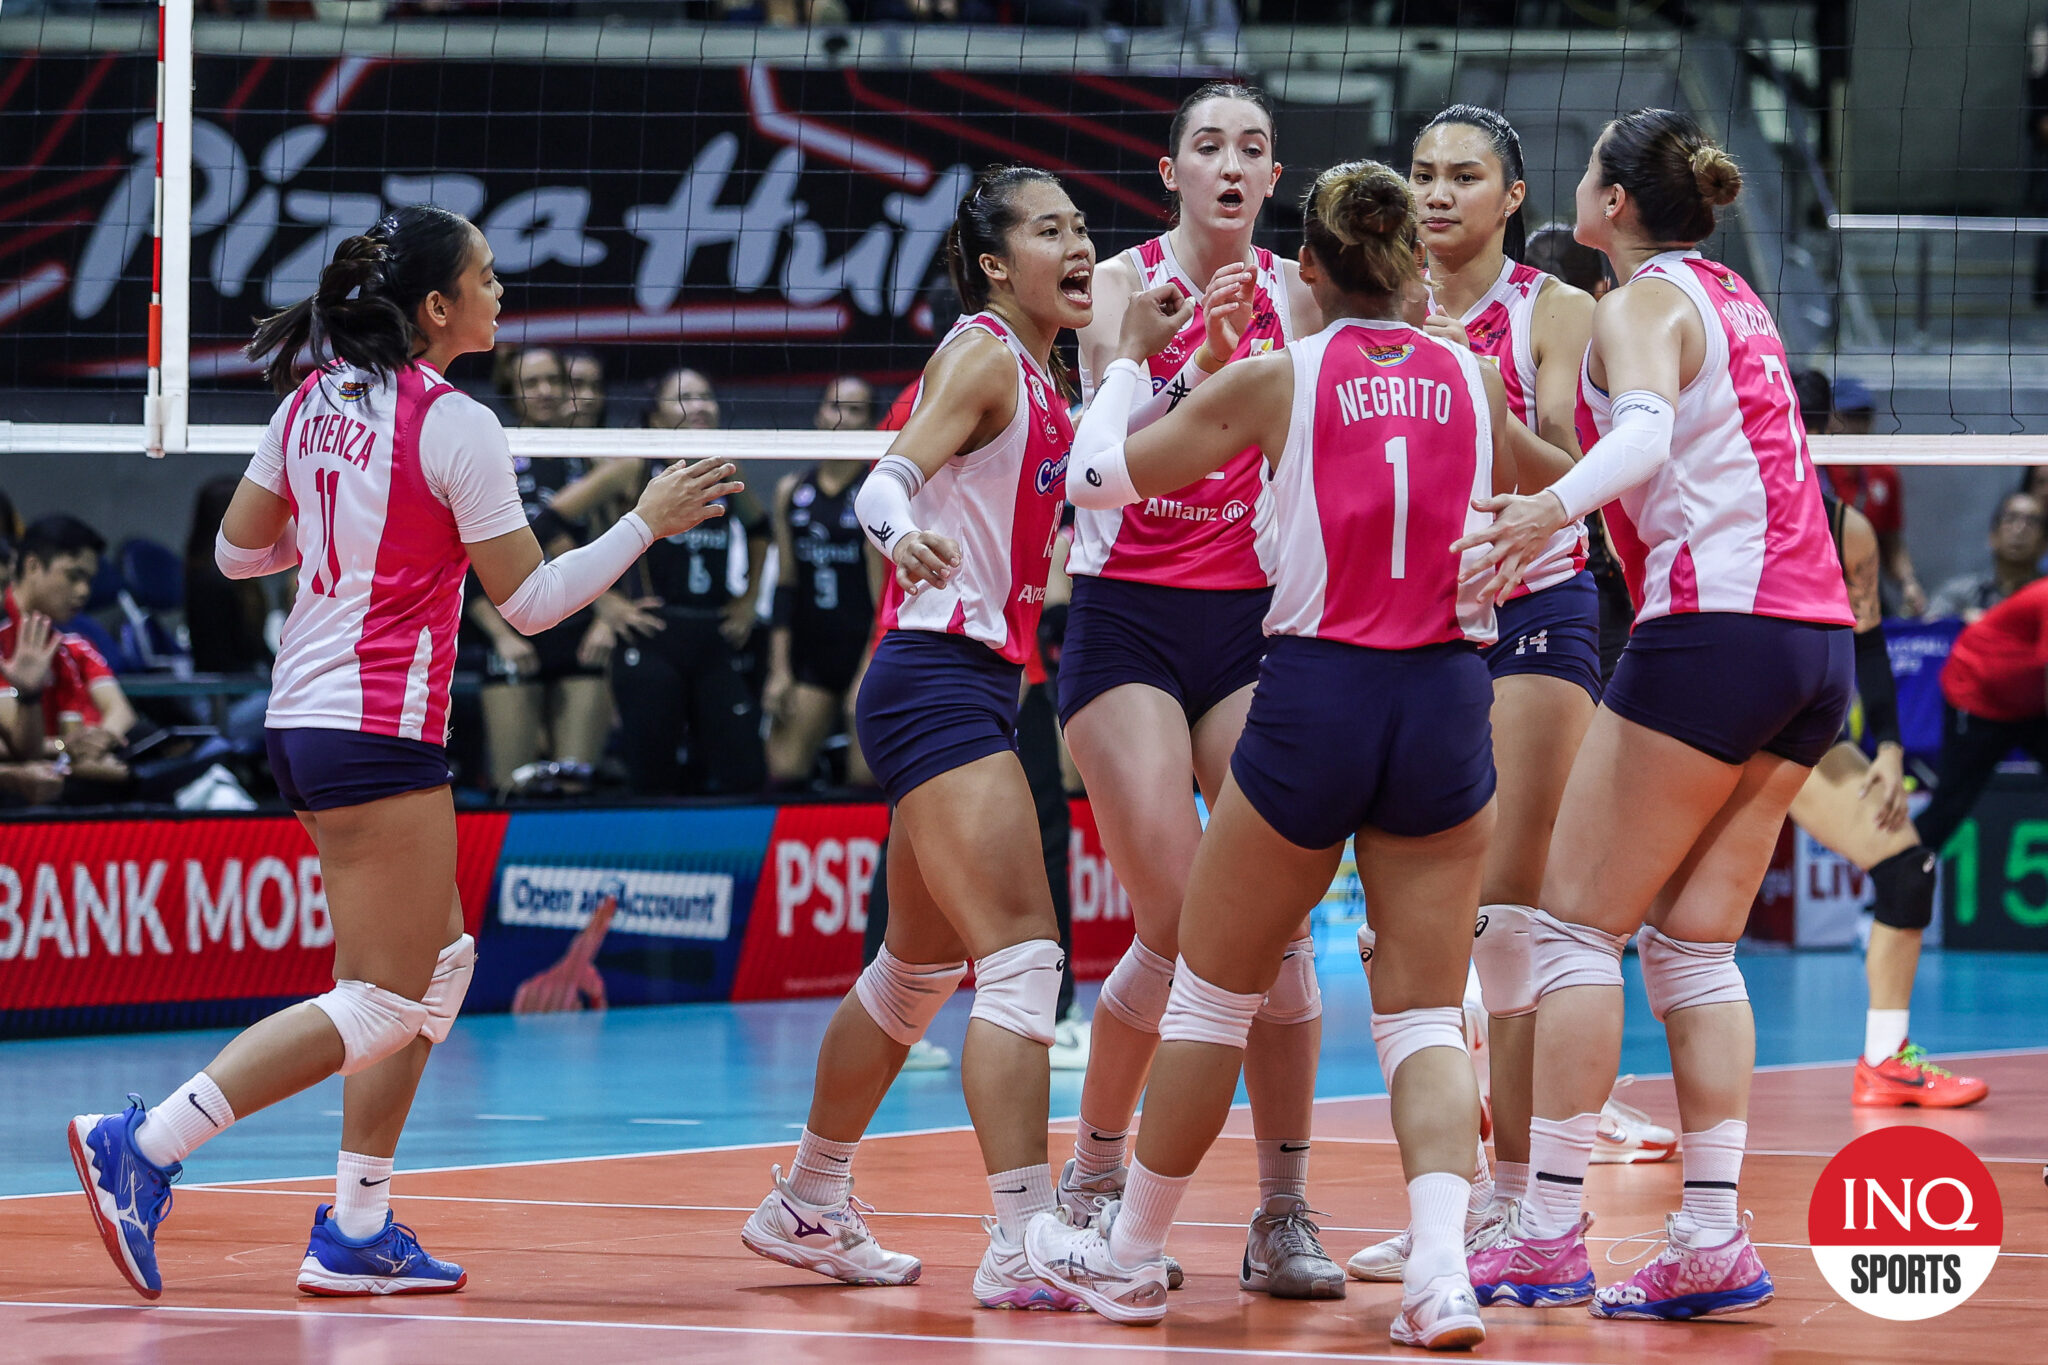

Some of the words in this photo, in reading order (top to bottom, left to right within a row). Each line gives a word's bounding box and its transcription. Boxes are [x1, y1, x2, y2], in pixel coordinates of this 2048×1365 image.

[624, 131, 972, 318] Hut
[298, 414, 377, 472] ATIENZA
[1335, 376, 1452, 426] NEGRITO
[1759, 354, 1806, 482] 7
[311, 467, 341, 599] 11
[1143, 497, 1218, 522] Allianz
[1384, 436, 1409, 580] 1
[1514, 629, 1548, 655] 14
[1942, 816, 2048, 928] 15
